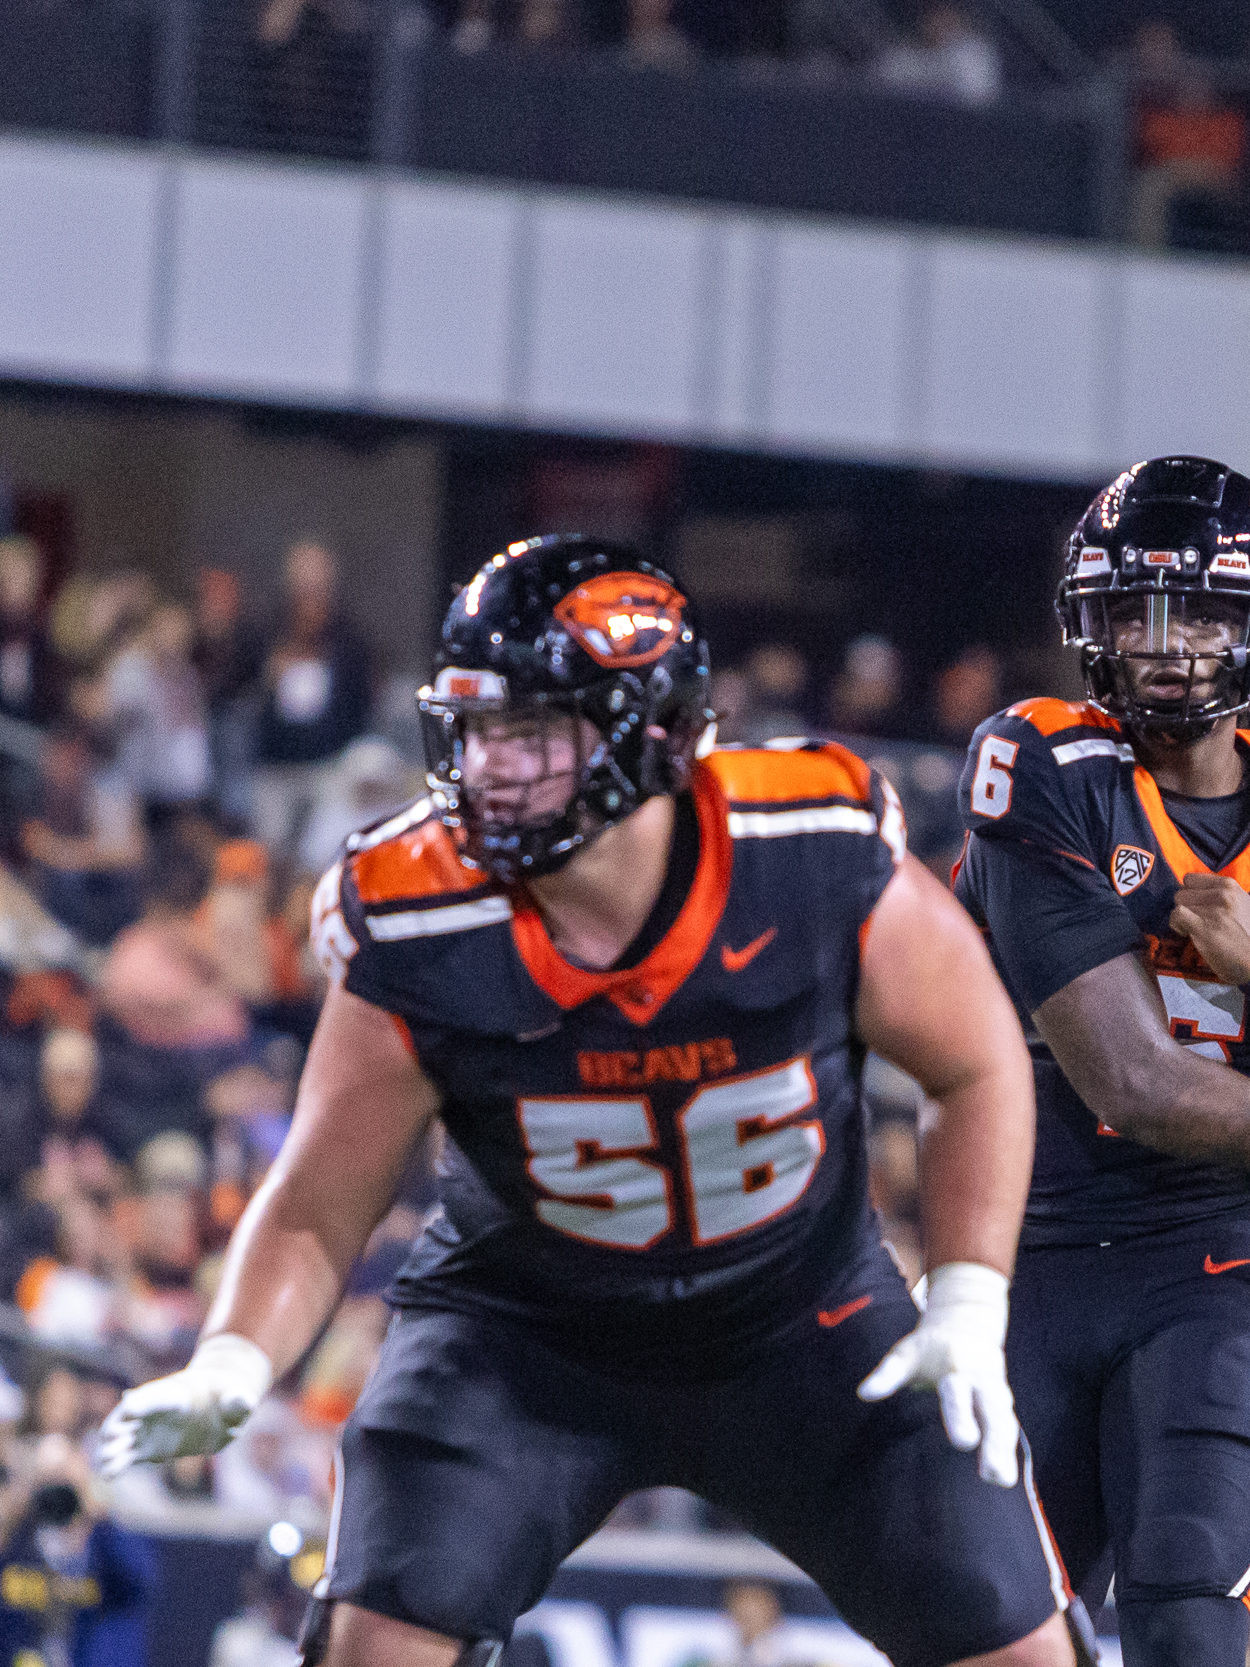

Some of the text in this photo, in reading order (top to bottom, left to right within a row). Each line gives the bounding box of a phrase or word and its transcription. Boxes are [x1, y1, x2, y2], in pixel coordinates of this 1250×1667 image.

[971, 734, 1020, 820] 6
[1115, 849, 1151, 879] PAC
[1117, 867, 1137, 886] 12
[515, 1052, 827, 1251] 56
